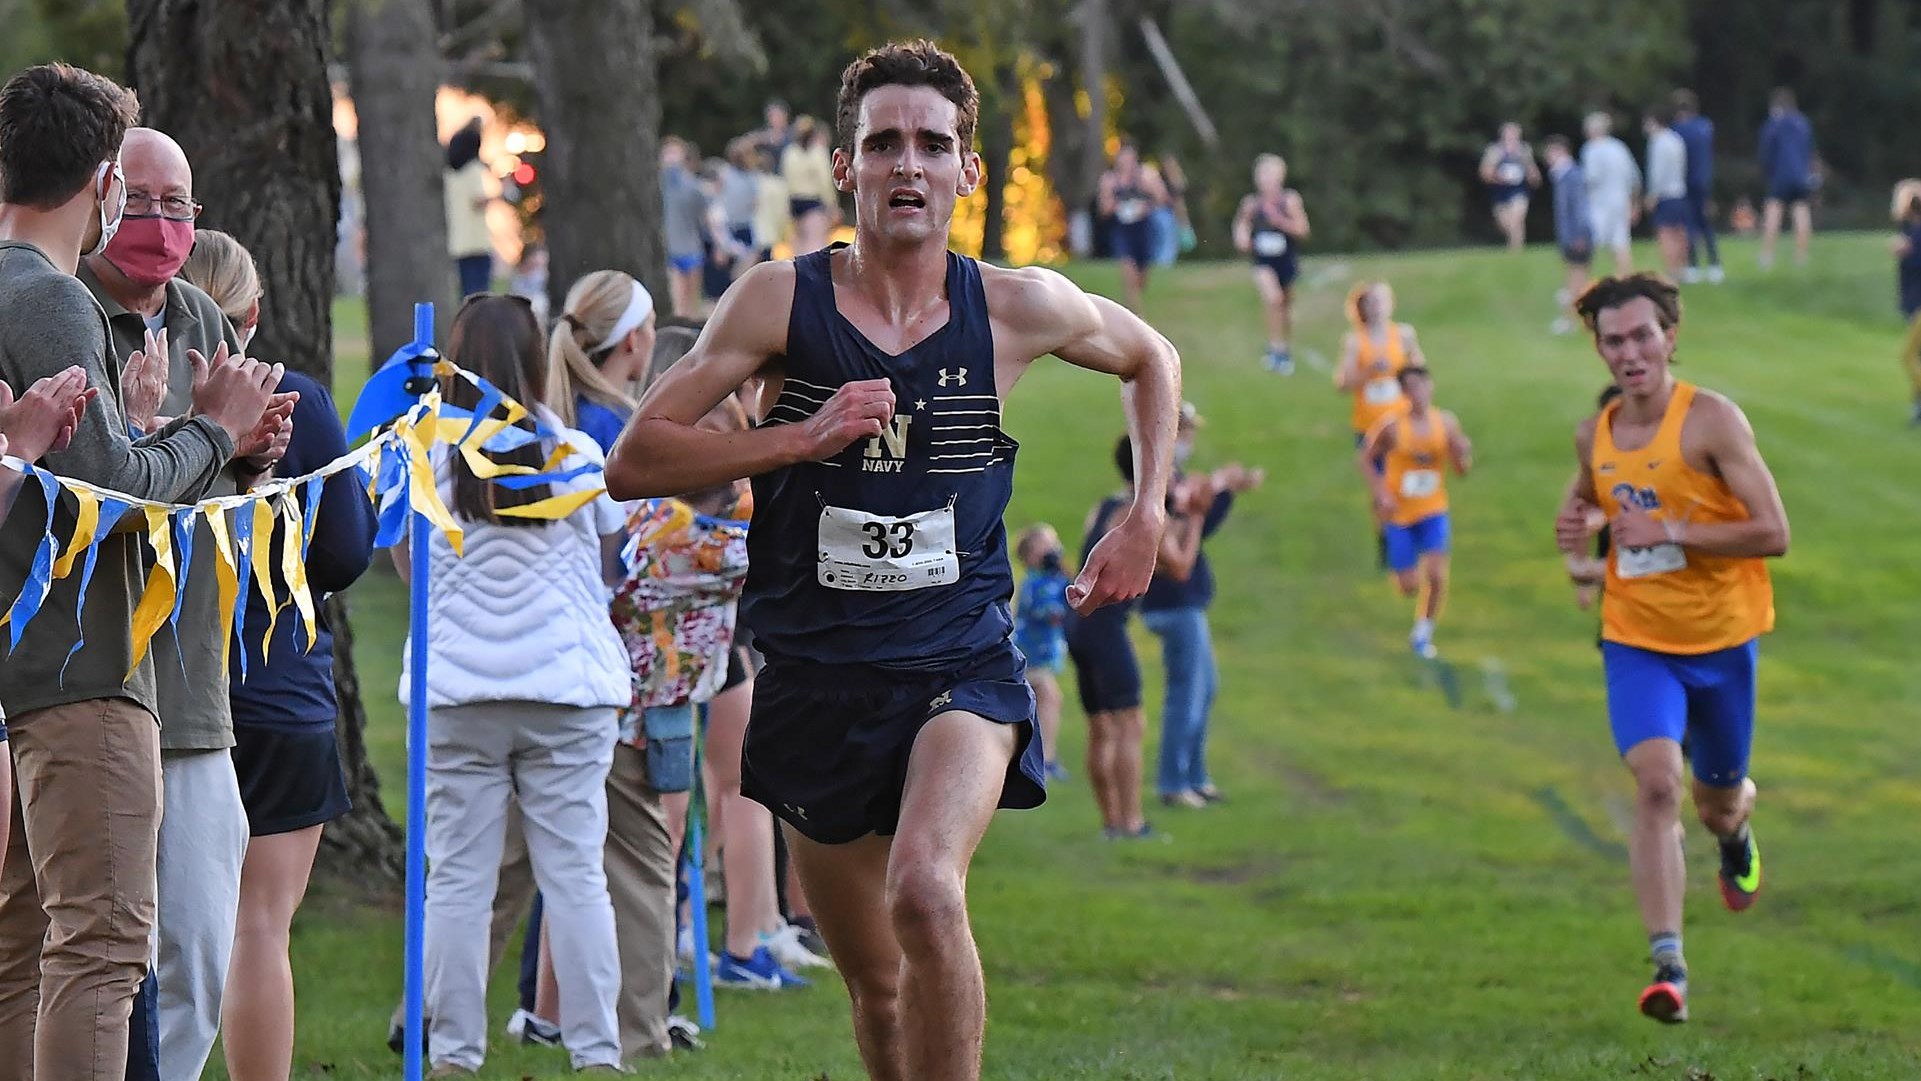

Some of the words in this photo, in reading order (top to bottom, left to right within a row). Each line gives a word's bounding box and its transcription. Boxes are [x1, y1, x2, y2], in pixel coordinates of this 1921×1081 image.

[863, 414, 913, 459] N
[862, 459, 905, 473] NAVY
[861, 521, 914, 560] 33
